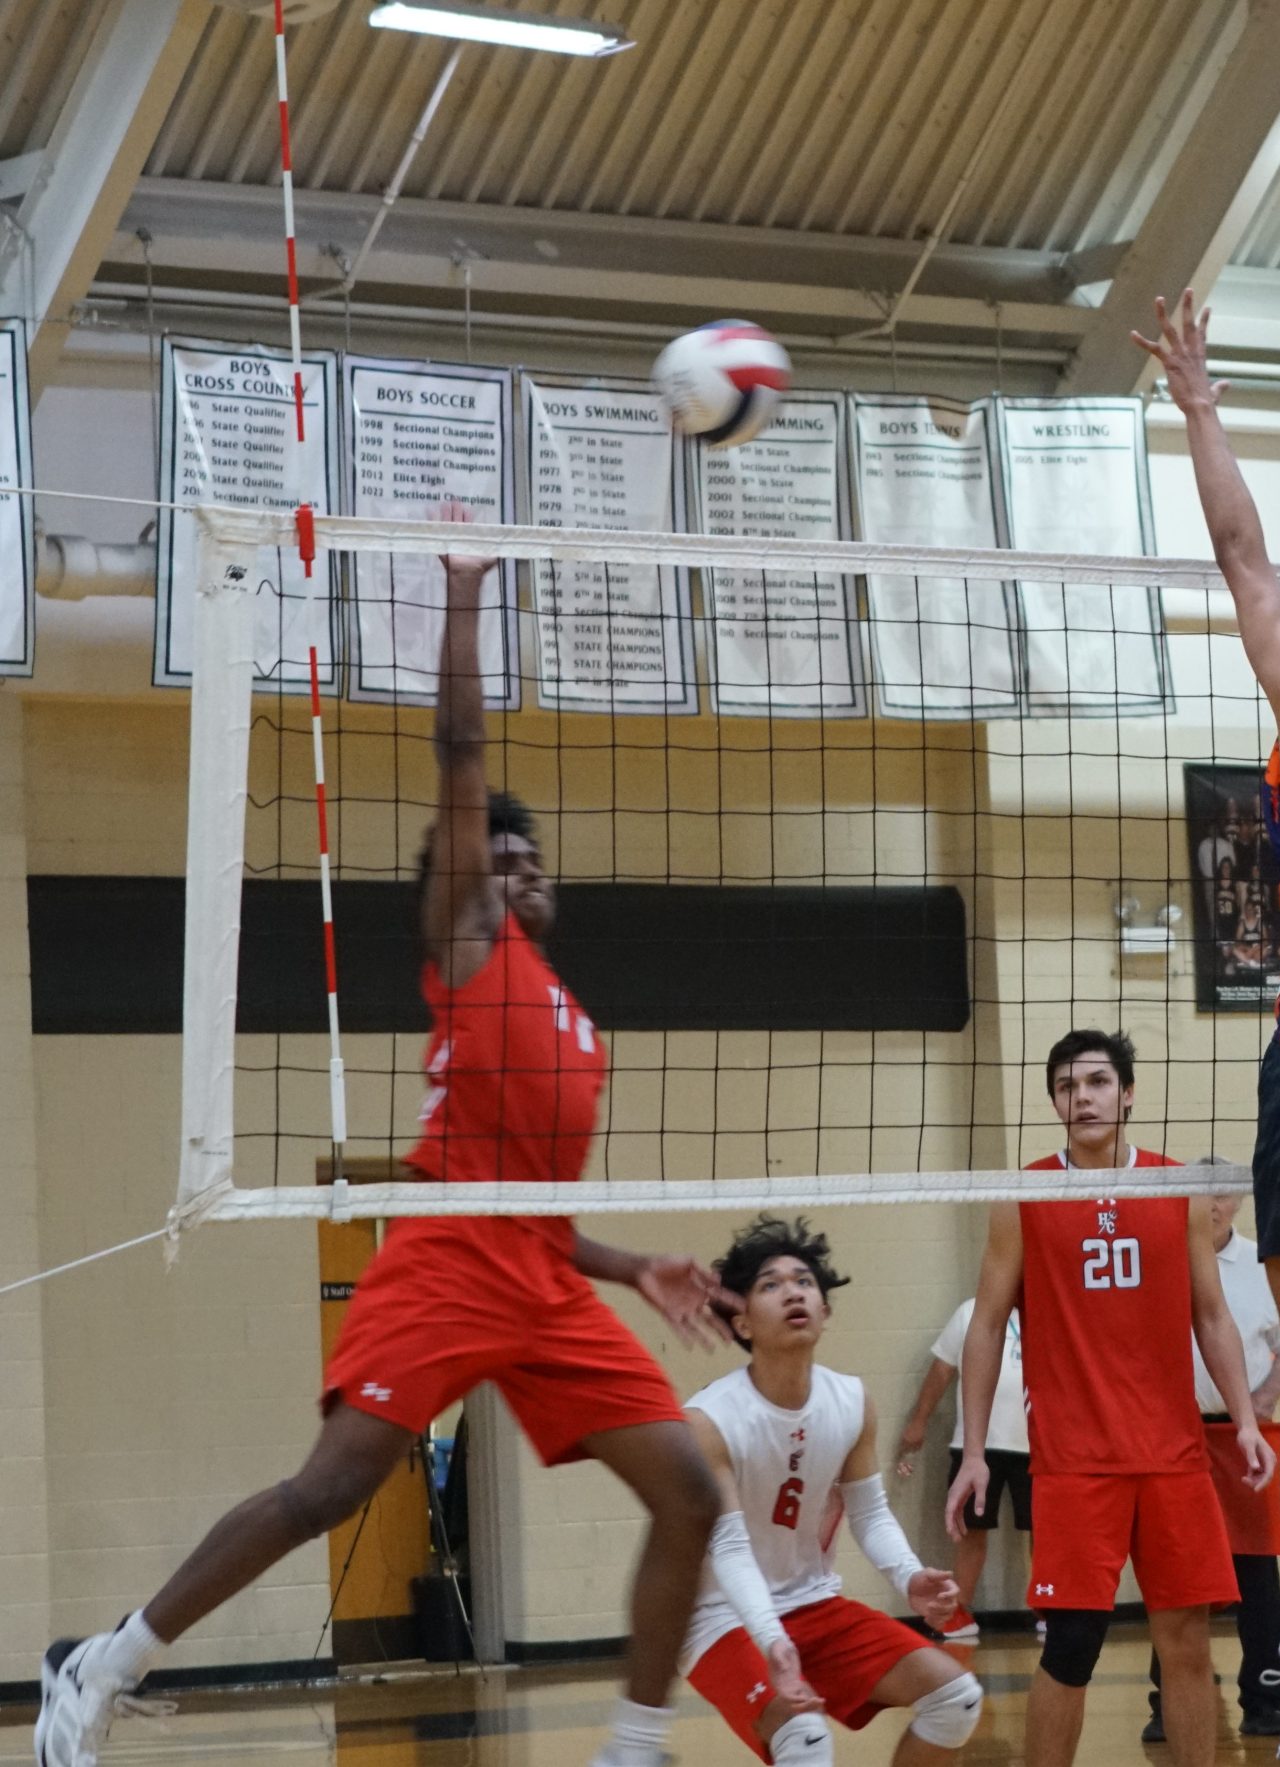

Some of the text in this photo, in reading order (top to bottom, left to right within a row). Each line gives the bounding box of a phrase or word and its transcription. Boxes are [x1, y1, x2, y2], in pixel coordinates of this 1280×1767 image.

[231, 361, 271, 376] BOYS
[185, 374, 235, 391] CROSS
[377, 387, 476, 409] BOYS SOCCER
[212, 403, 239, 413] State
[245, 405, 286, 419] Qualifier
[543, 402, 658, 422] BOYS SWIMMING
[212, 421, 285, 436] State Qualifier
[361, 419, 494, 440] 1998 Sectional Champions
[770, 418, 824, 430] IMMING
[880, 421, 918, 434] BOYS
[1033, 424, 1110, 437] WRESTLING
[211, 439, 284, 454] State Qualifier
[361, 436, 495, 456] 1999 Sectional Champions
[587, 438, 596, 447] in
[601, 438, 623, 448] State
[587, 454, 595, 463] in
[601, 456, 623, 465] State
[767, 448, 790, 456] State
[211, 456, 238, 466] State
[243, 457, 283, 472] Qualifier
[361, 452, 496, 473] 2001 Sectional Champions
[212, 474, 237, 485] State
[243, 475, 283, 489] Qualifier
[361, 469, 445, 486] 2012 Elite Eight
[601, 473, 624, 483] State
[771, 479, 793, 487] State
[213, 491, 258, 504] Sectional
[393, 489, 440, 500] Sectional
[539, 484, 561, 493] 1978
[602, 490, 626, 499] State
[539, 501, 561, 511] 1979
[602, 507, 626, 516] State
[742, 510, 784, 520] Sectional
[774, 529, 796, 537] State
[574, 625, 602, 634] STATE
[607, 626, 660, 637] CHAMPIONS
[574, 642, 602, 651] STATE
[607, 643, 662, 655] CHAMPIONS
[574, 659, 602, 669] STATE
[607, 660, 663, 671] CHAMPIONS
[1082, 1238, 1141, 1289] 20
[771, 1476, 804, 1530] 6
